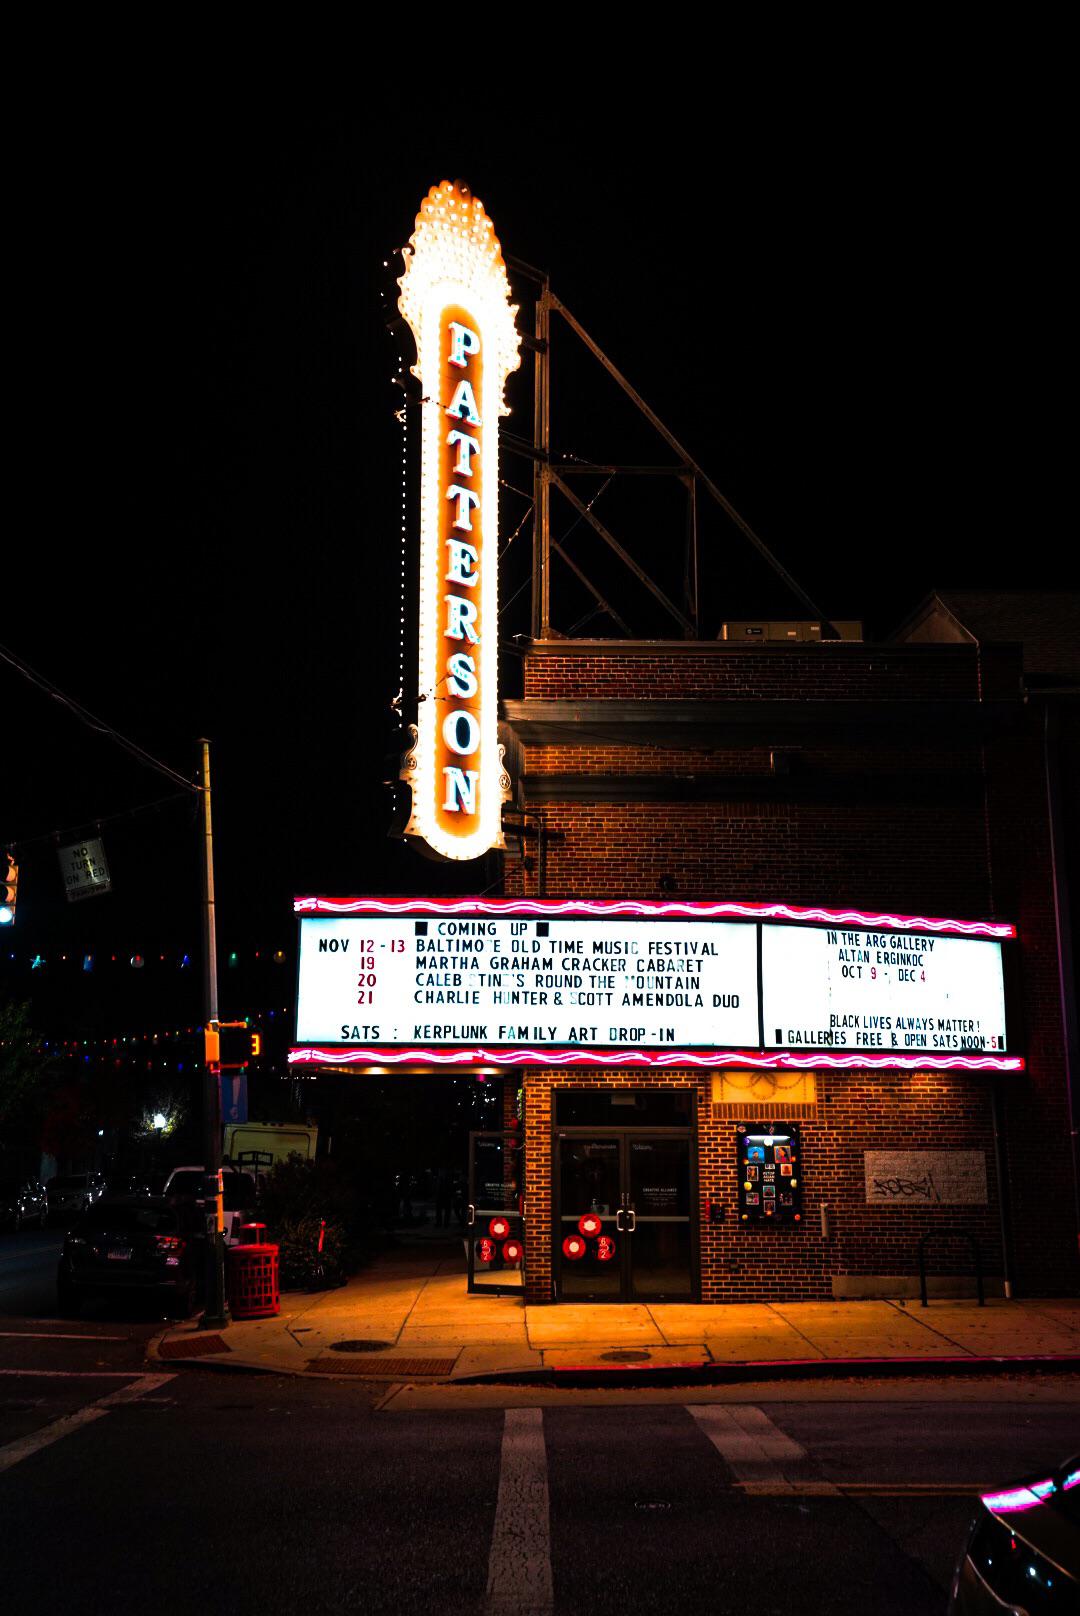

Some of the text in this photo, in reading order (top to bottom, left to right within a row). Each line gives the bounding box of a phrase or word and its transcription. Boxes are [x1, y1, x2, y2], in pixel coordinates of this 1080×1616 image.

[443, 320, 482, 814] PATTERSON
[73, 847, 88, 858] NO
[71, 856, 96, 871] TURN
[66, 867, 105, 885] ON RED
[438, 922, 527, 936] COMING UP
[319, 939, 349, 952] NOV
[361, 940, 374, 952] 12
[391, 940, 405, 952] 13
[512, 940, 540, 953] OLD
[549, 941, 583, 954] TIME
[593, 941, 638, 954] MUSIC
[649, 942, 718, 955] FESTIVAL
[827, 931, 935, 951] IN THE ARG GALLERY
[361, 957, 374, 970] 19
[416, 956, 703, 972] MARTHA GRAHAM CRACKER CABARET
[839, 949, 869, 963] ALTAN
[358, 974, 376, 987] 20
[416, 973, 461, 986] CALEB
[536, 974, 582, 988] ROUND
[589, 975, 615, 988] THE
[842, 965, 862, 978] OCT
[871, 967, 876, 979] 9
[899, 969, 915, 982] DEC
[920, 970, 926, 983] 4
[358, 991, 372, 1004] 21
[414, 990, 480, 1004] CHARLIE
[494, 991, 547, 1005] HUNTER
[554, 992, 563, 1005] &
[622, 993, 703, 1007] AMENDOLA
[713, 994, 739, 1008] DUO
[830, 1014, 859, 1029] BLACK
[864, 1016, 891, 1029] LIVES
[896, 1017, 934, 1030] ALWAYS
[341, 1025, 379, 1039] SATS
[414, 1025, 487, 1039] KERPLUNK
[499, 1026, 557, 1040] FAMILY
[568, 1027, 598, 1041] ART
[856, 1032, 882, 1046] FREE
[891, 1032, 898, 1047] &
[905, 1034, 926, 1046] OPEN
[933, 1034, 958, 1048] SATS
[251, 1034, 260, 1056] 3
